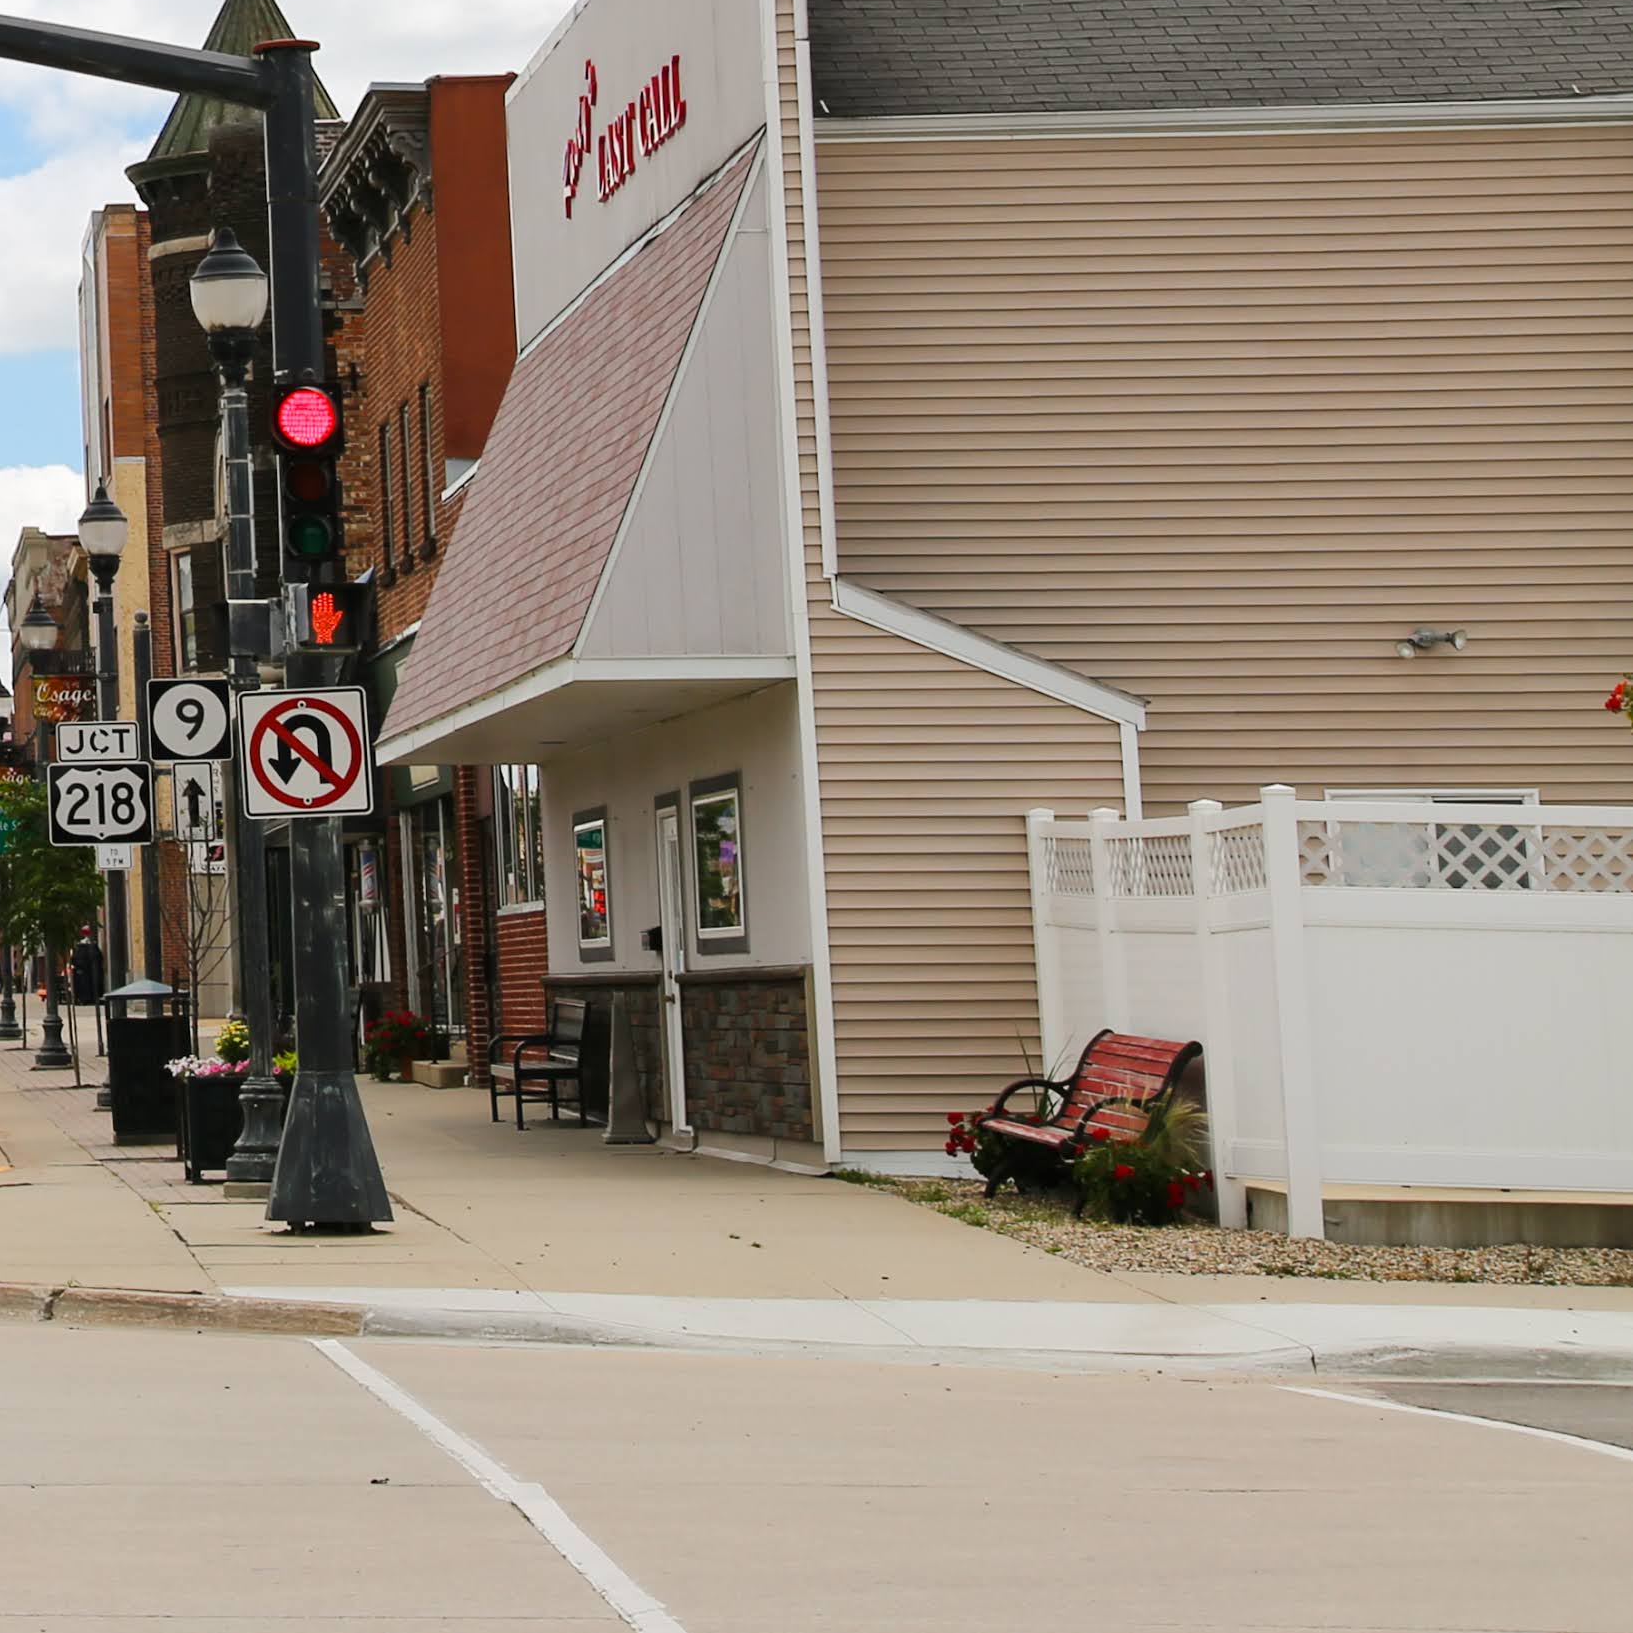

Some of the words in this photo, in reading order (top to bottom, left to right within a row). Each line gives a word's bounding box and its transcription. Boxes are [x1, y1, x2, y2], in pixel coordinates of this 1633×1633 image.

[597, 101, 635, 203] LAST
[638, 54, 687, 158] CALL
[36, 682, 93, 706] Osage
[175, 698, 205, 741] 9
[65, 728, 131, 755] JCT
[66, 781, 136, 826] 218
